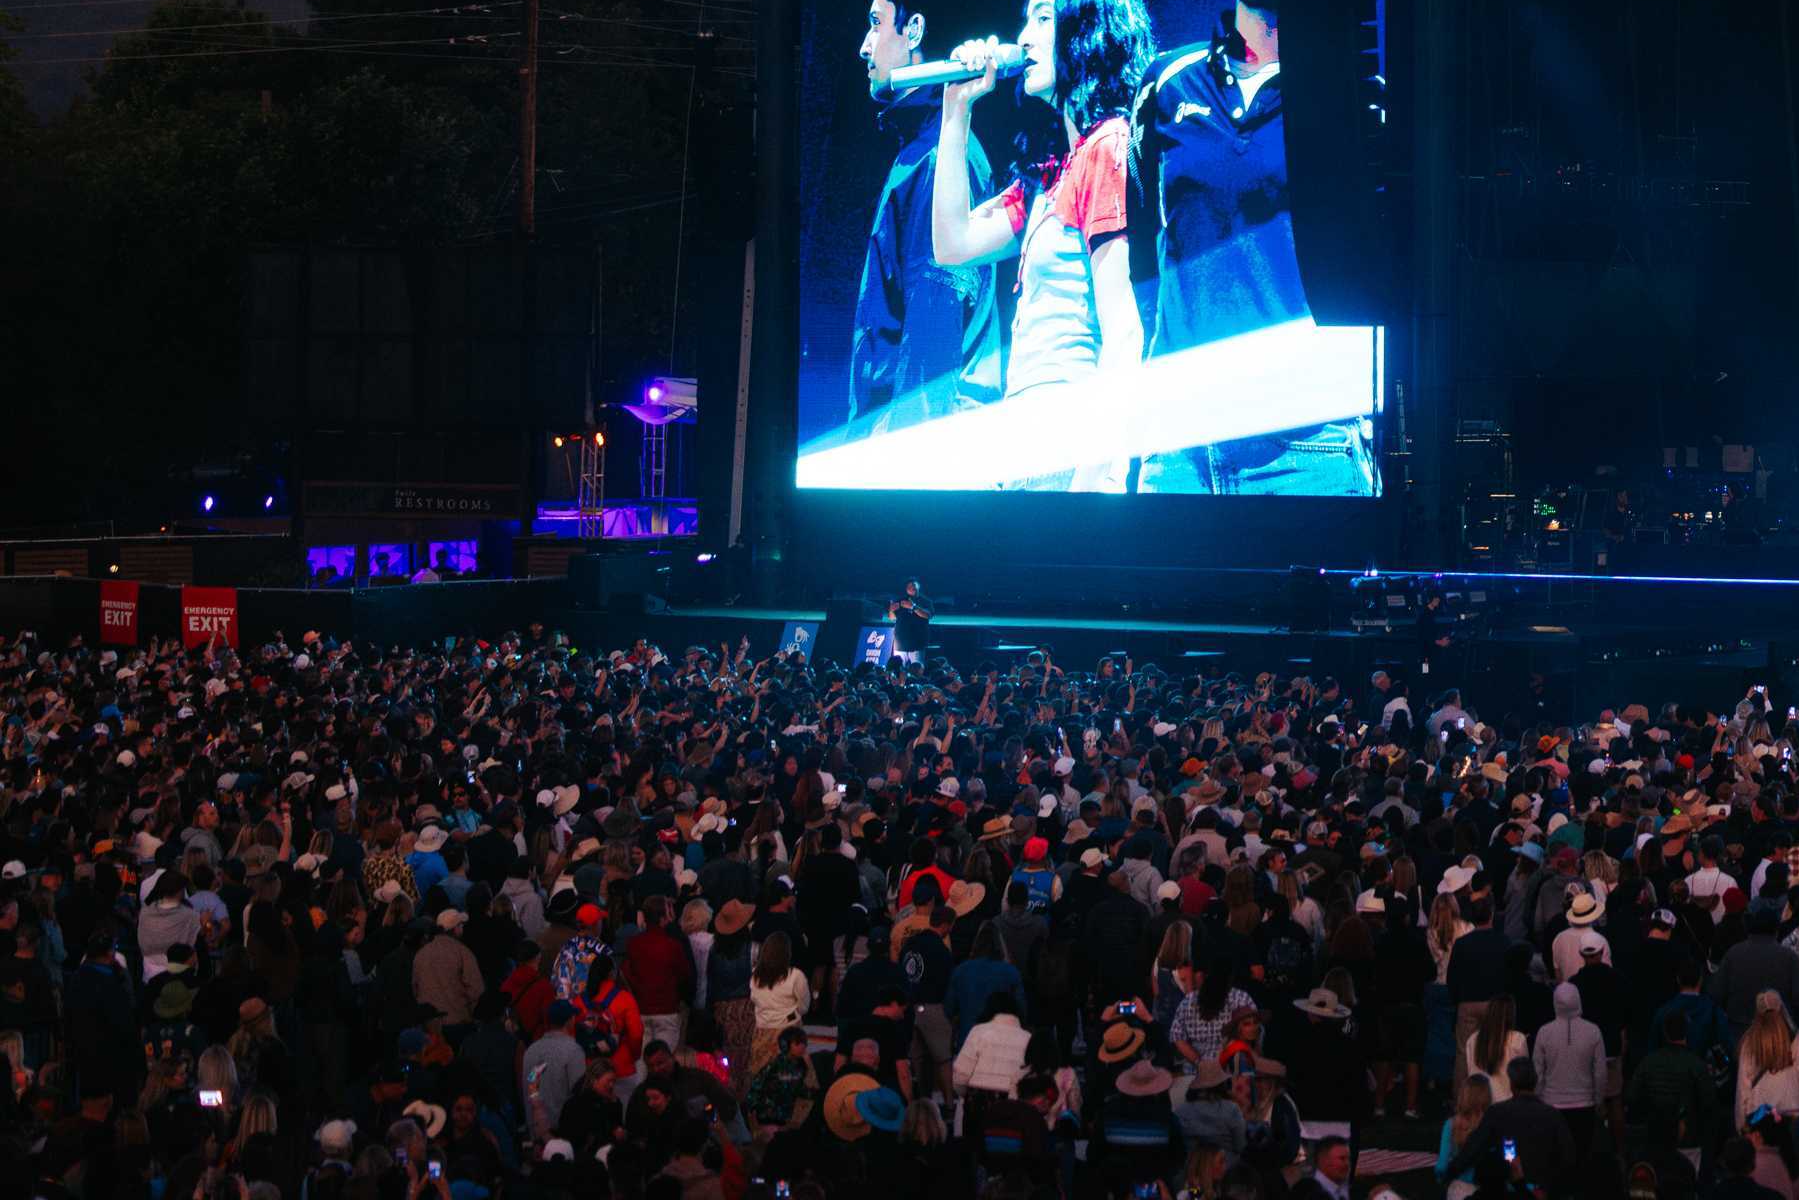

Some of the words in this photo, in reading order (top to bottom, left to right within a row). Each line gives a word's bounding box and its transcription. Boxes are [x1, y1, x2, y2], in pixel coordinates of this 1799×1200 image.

[395, 497, 490, 510] RESTROOMS
[184, 606, 235, 615] EMERGENCY
[104, 610, 133, 626] EXIT
[188, 616, 230, 632] EXIT
